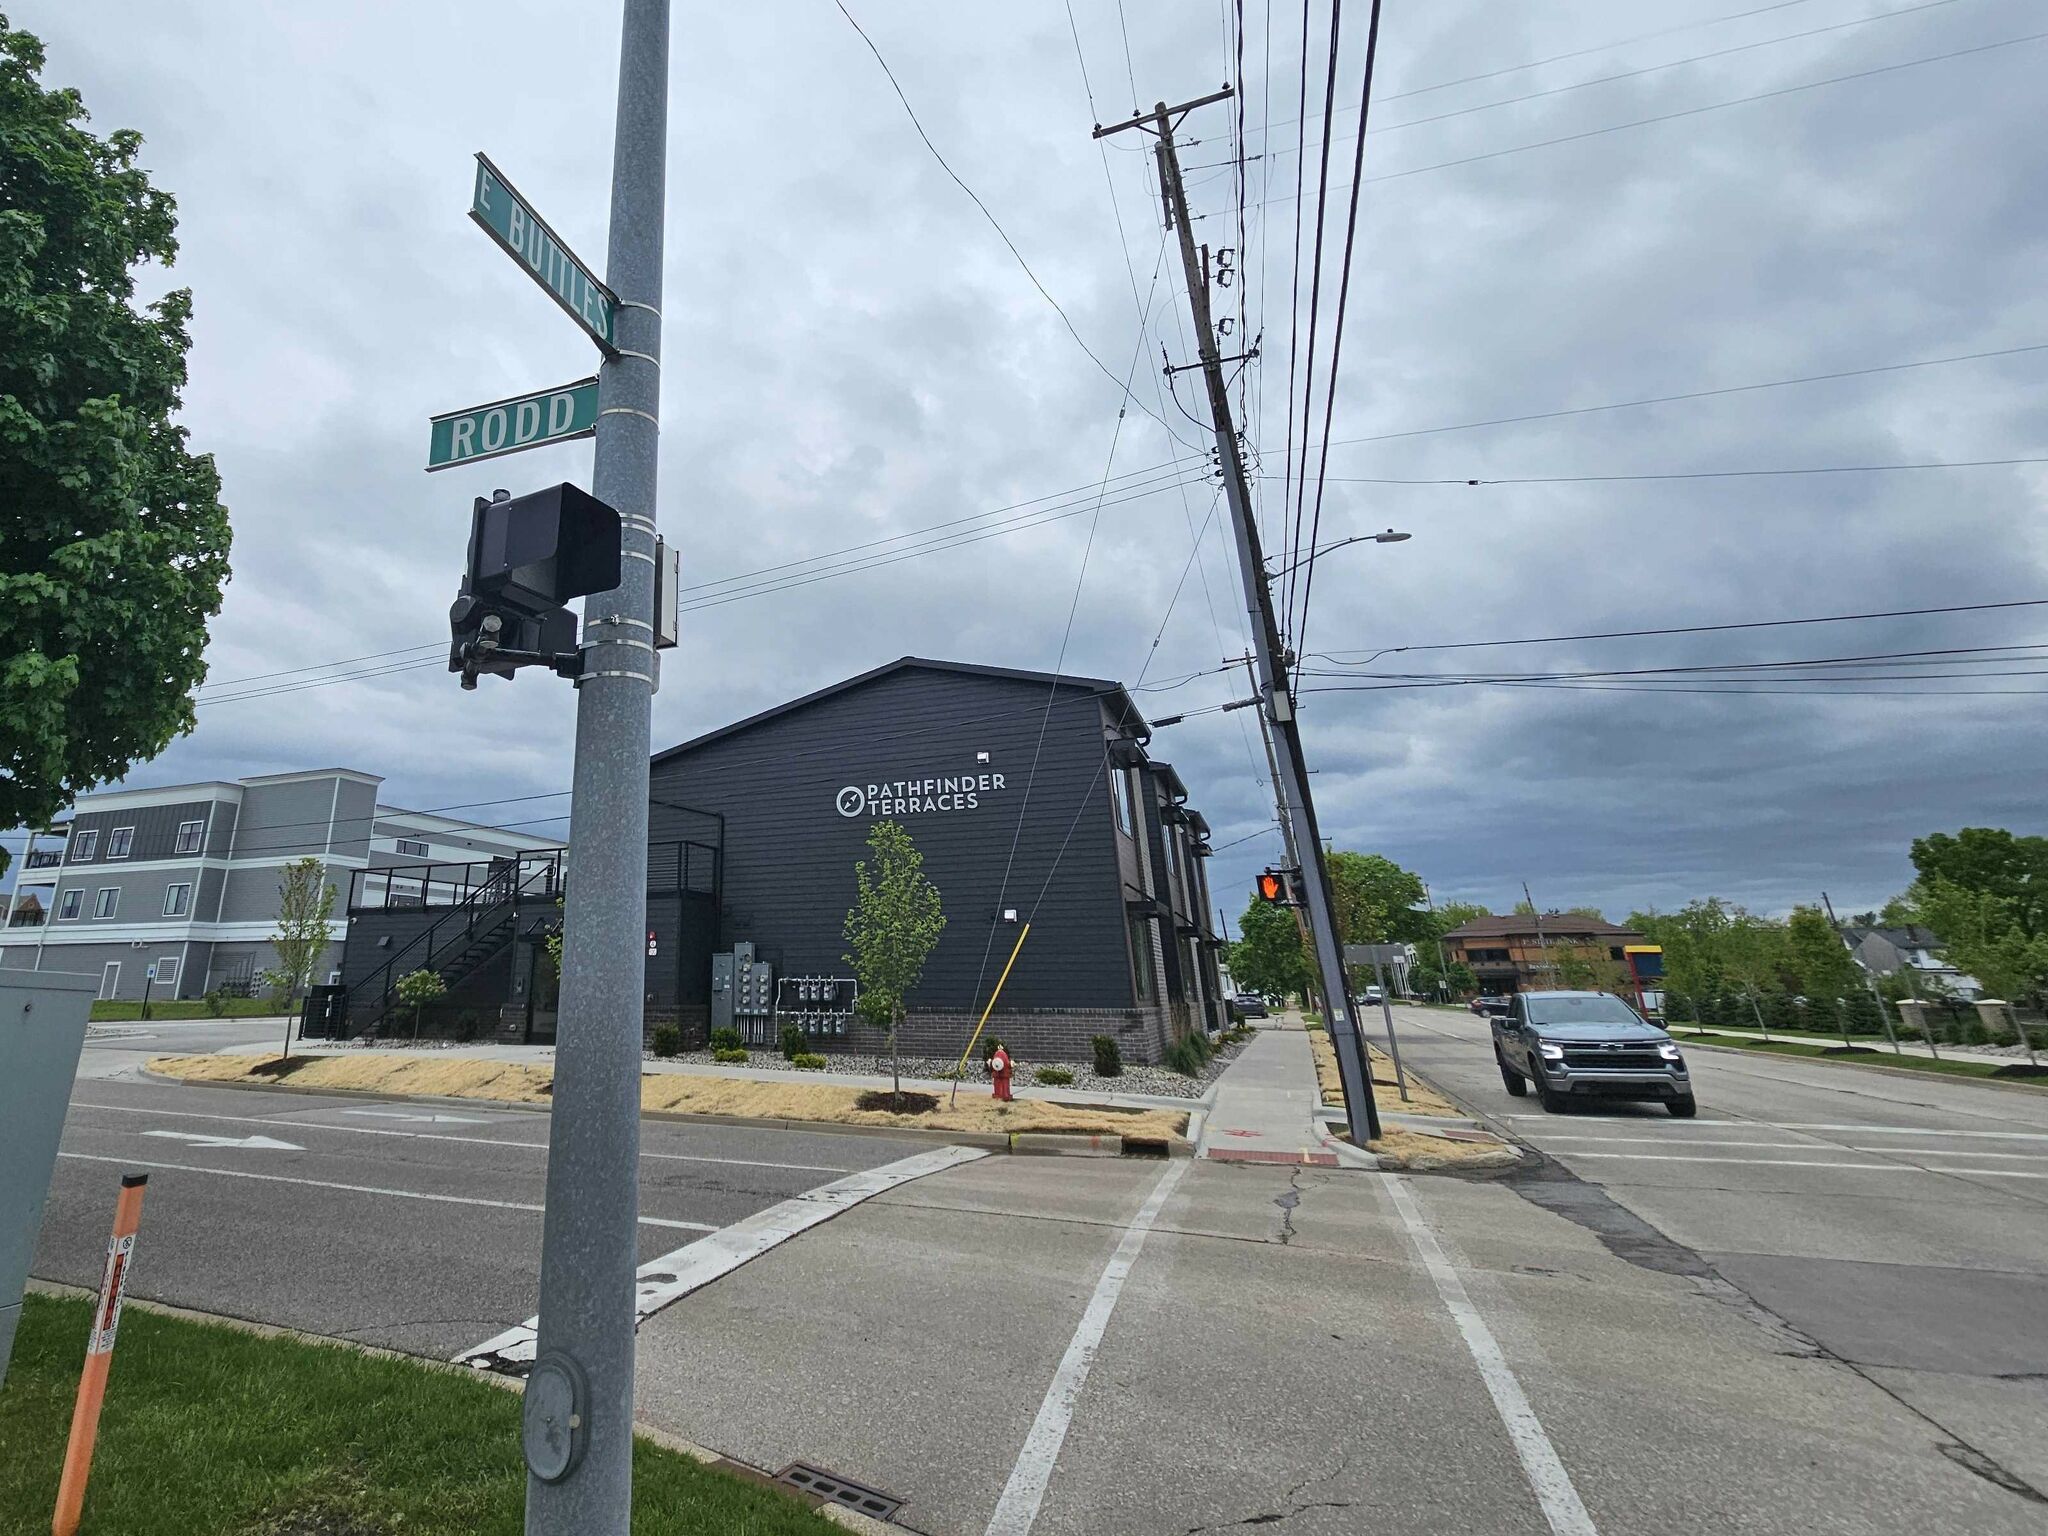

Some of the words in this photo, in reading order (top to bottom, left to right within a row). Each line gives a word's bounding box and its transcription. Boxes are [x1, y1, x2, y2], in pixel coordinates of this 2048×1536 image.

[479, 168, 495, 211] E
[508, 198, 609, 341] BUTTLES
[451, 393, 575, 460] RODD
[867, 773, 1006, 800] PATHFINDER
[867, 792, 979, 816] TERRACES
